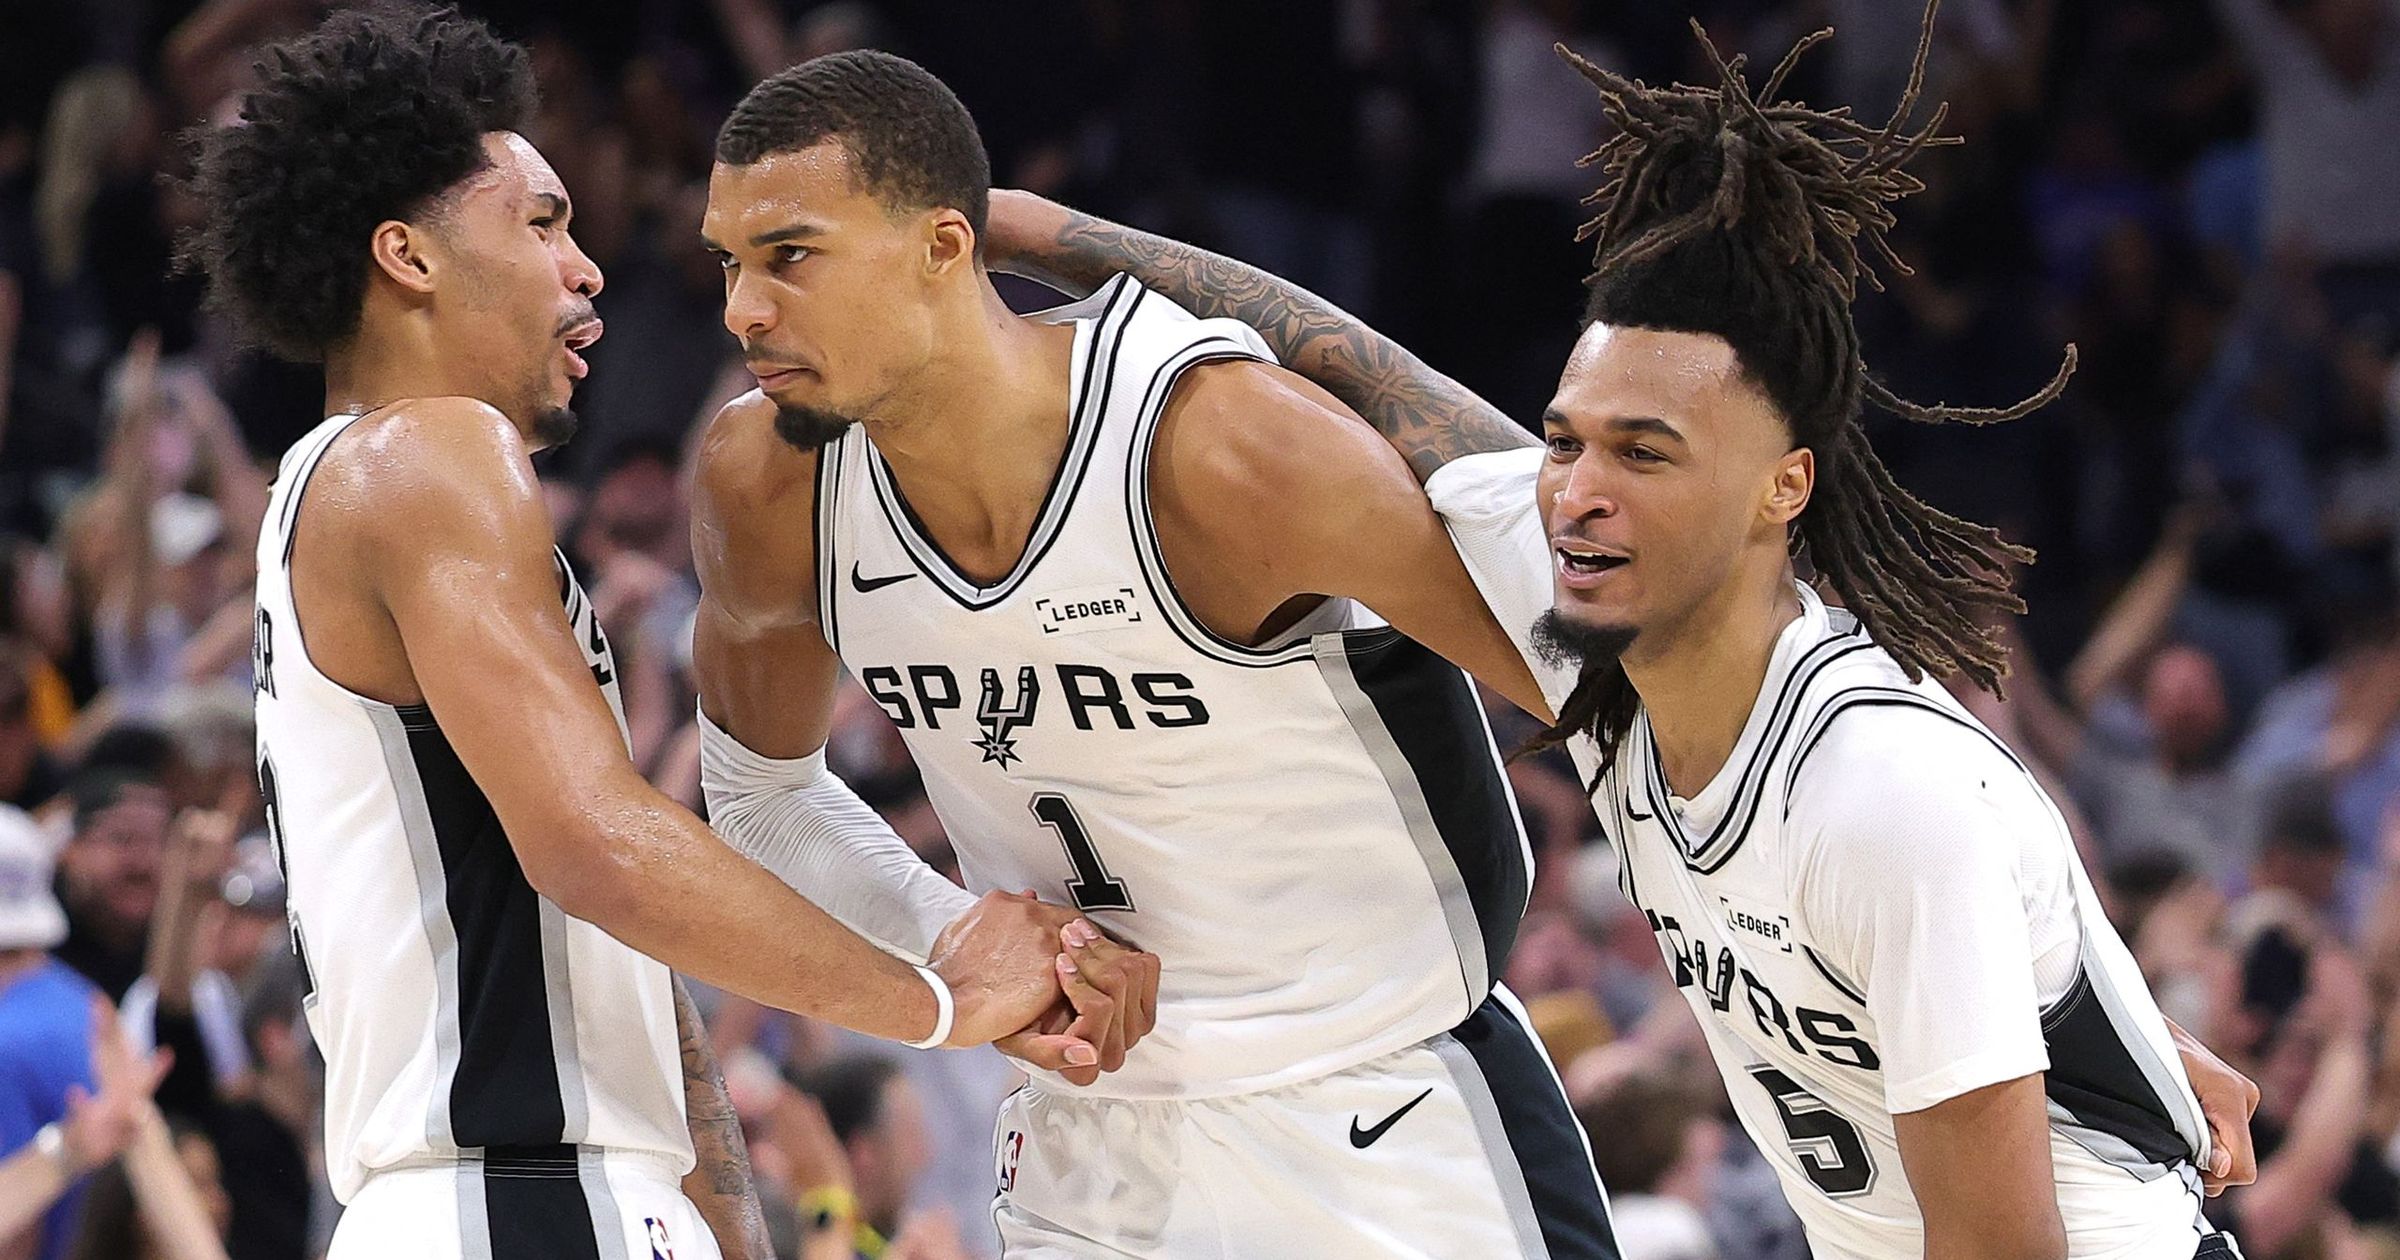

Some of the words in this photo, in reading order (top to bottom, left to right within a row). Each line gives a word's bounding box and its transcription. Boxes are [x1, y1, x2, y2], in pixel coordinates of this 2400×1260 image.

[1051, 599, 1127, 622] LEDGER
[862, 664, 1210, 771] SPURS
[1028, 791, 1137, 912] 1
[1729, 909, 1781, 941] LEDGER
[1646, 908, 1880, 1071] PURS
[1744, 1063, 1879, 1200] 5
